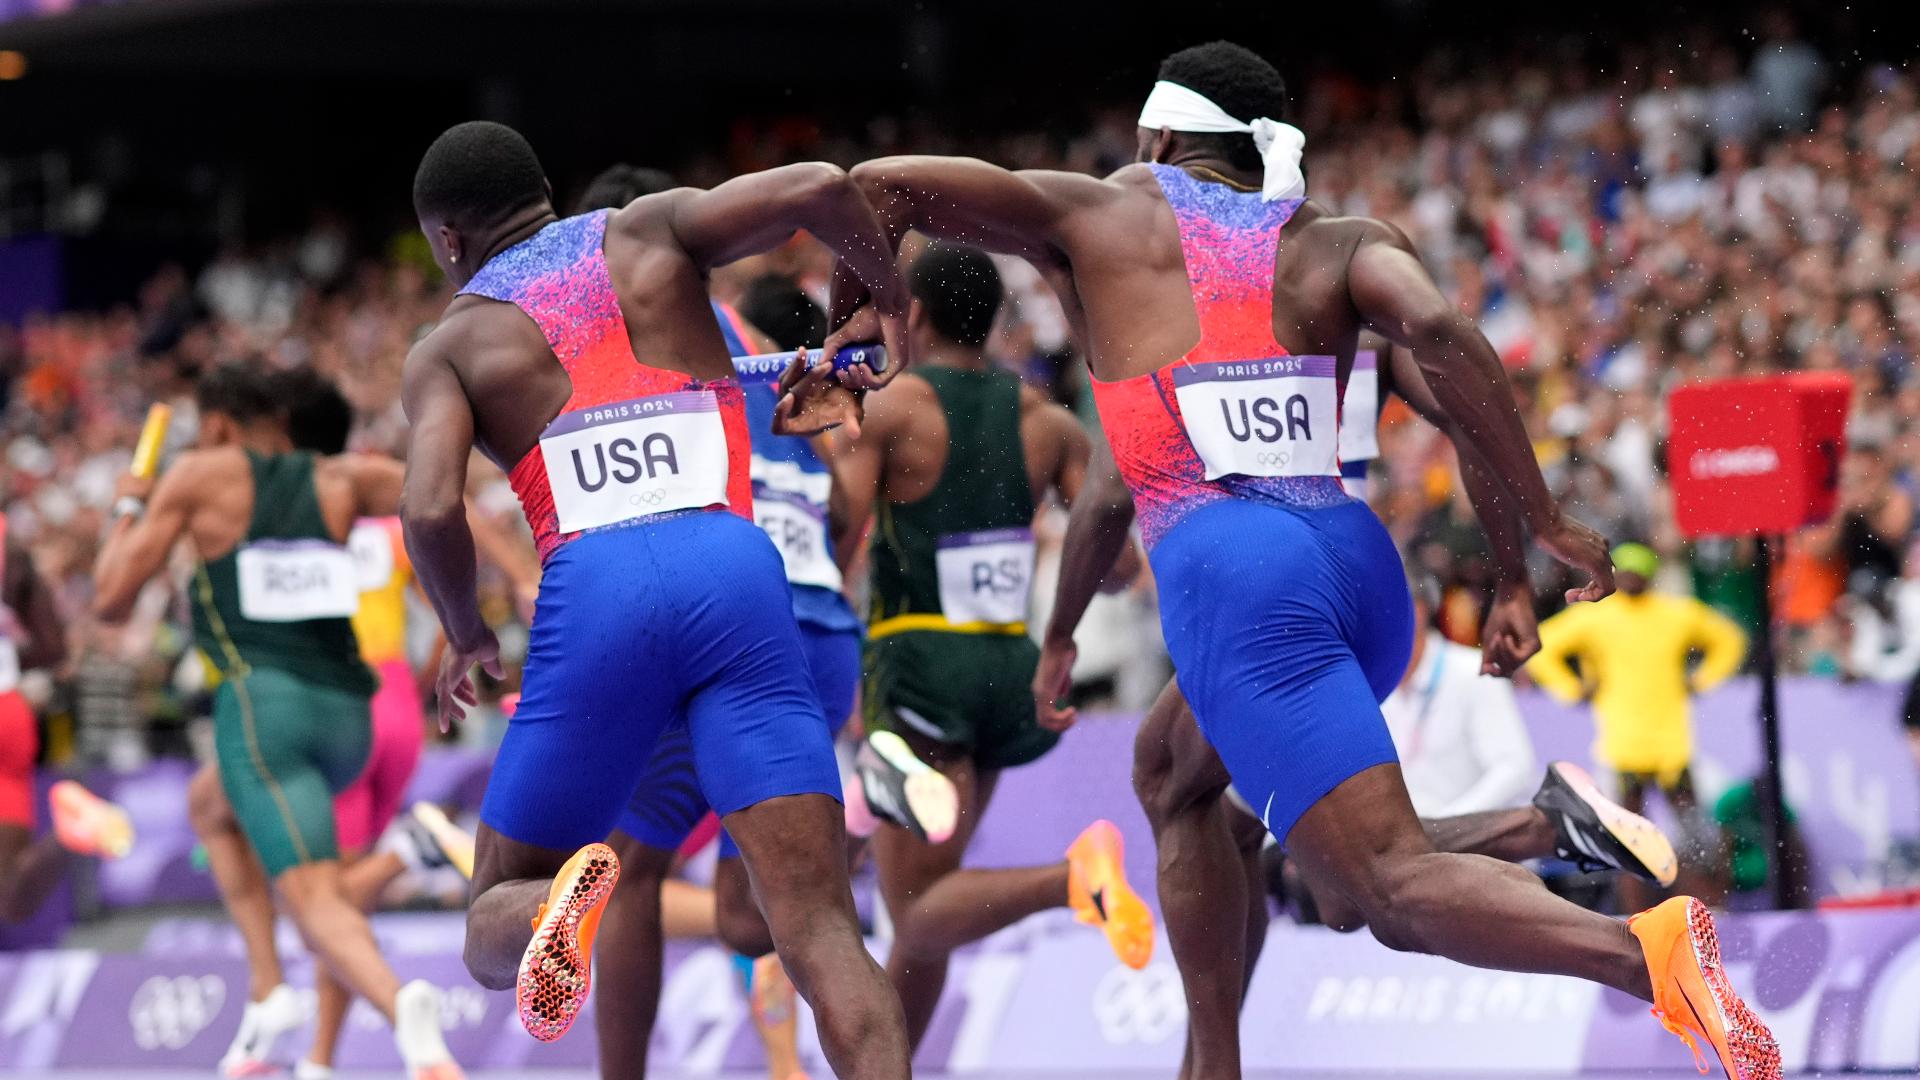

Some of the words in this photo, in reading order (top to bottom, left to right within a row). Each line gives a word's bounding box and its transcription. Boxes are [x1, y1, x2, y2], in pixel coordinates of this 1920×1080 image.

[738, 359, 780, 375] 2024
[1217, 365, 1259, 377] PARIS
[1264, 358, 1303, 374] 2024
[584, 407, 630, 424] PARIS
[633, 401, 674, 415] 2024
[1220, 393, 1312, 443] USA
[571, 432, 680, 493] USA
[971, 557, 1024, 598] RS
[1306, 976, 1451, 1023] PARIS
